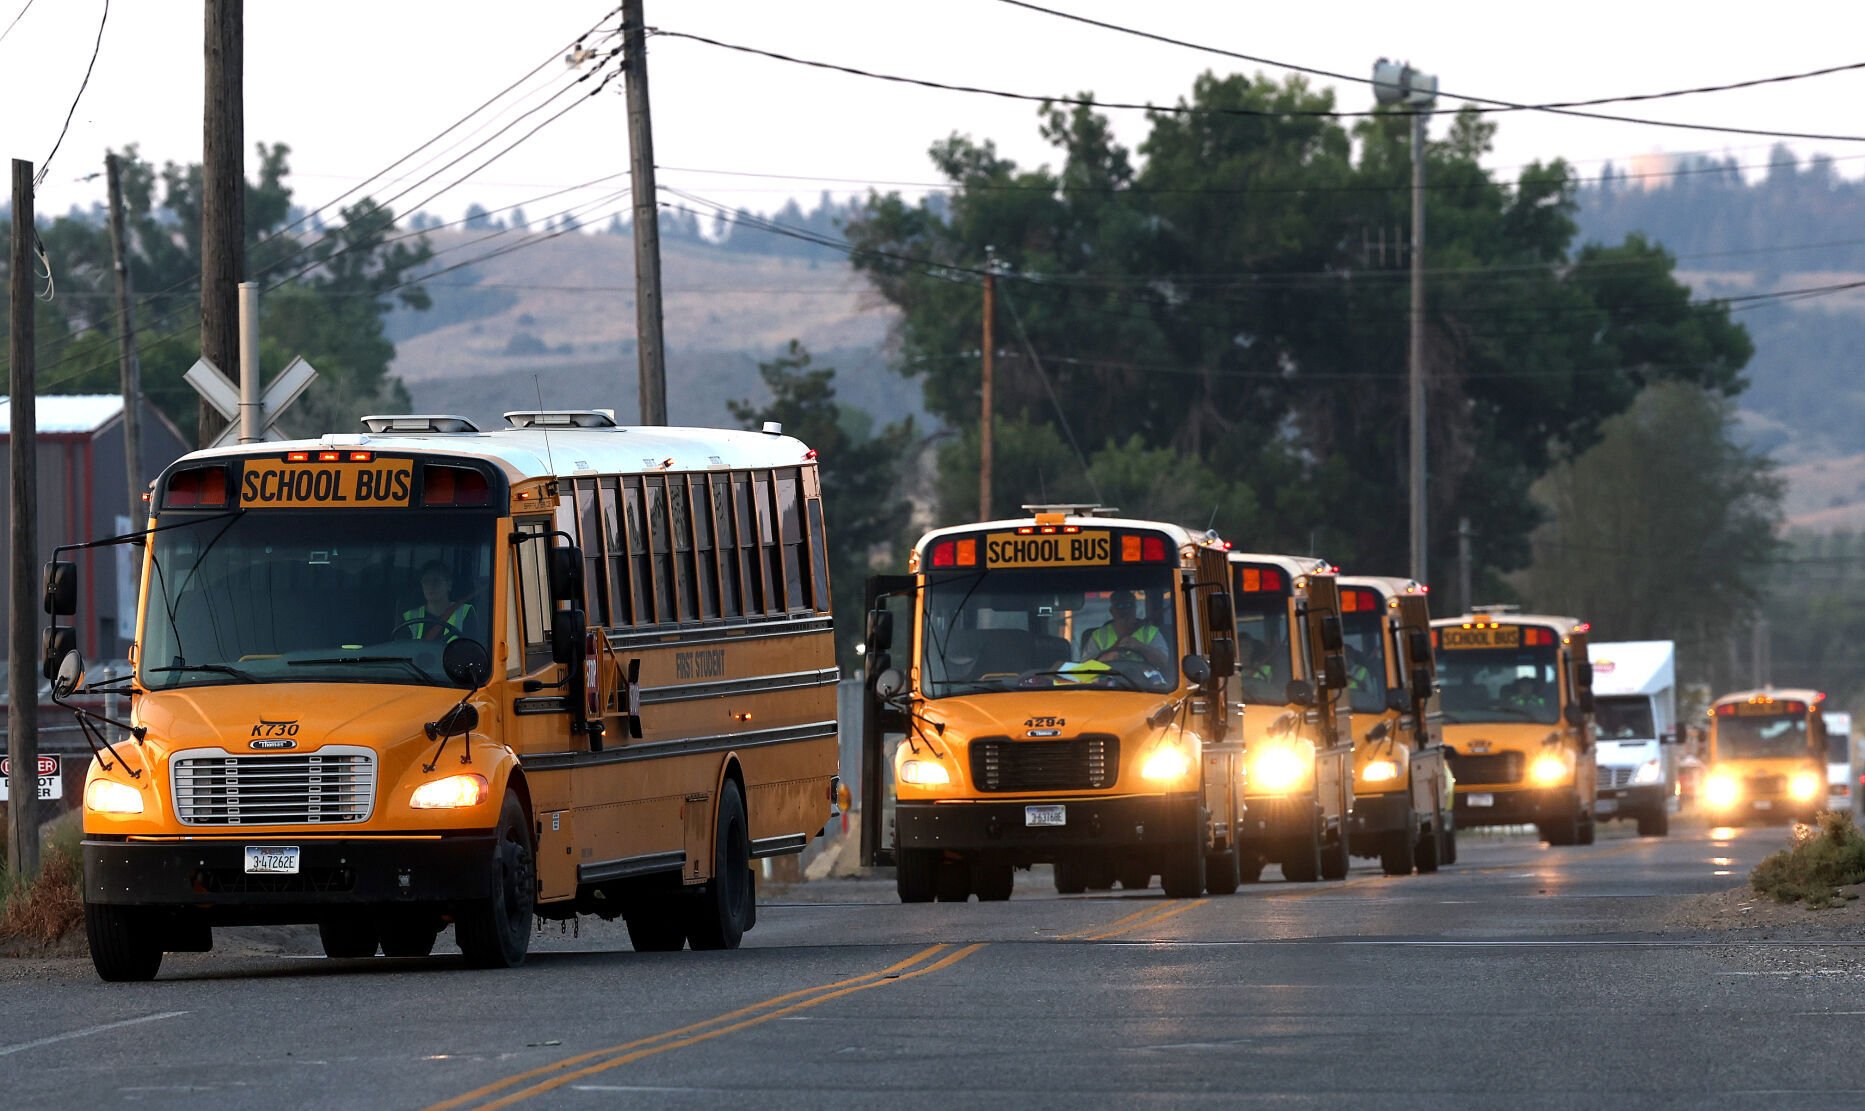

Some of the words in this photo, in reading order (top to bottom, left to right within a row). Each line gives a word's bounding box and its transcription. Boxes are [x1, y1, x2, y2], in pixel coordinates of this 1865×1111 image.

[242, 469, 347, 502] SCHOOL
[355, 469, 411, 501] BUS
[988, 540, 1065, 563] SCHOOL
[1071, 538, 1109, 561] BUS
[1444, 630, 1489, 646] SCHOOL
[1494, 629, 1518, 645] BUS
[676, 652, 693, 679] FIRST
[695, 649, 725, 677] STUDENT
[251, 724, 299, 736] K730
